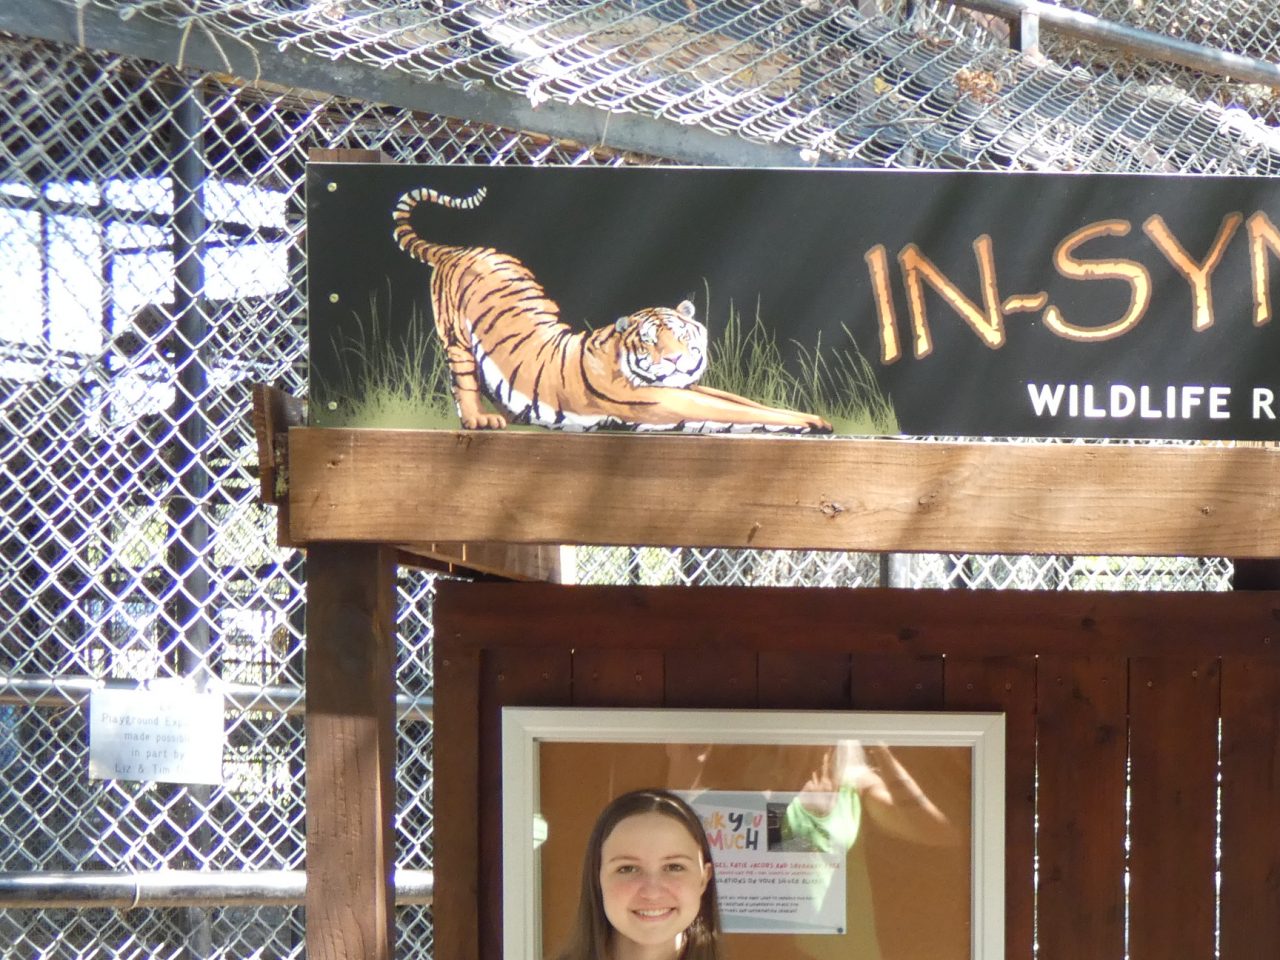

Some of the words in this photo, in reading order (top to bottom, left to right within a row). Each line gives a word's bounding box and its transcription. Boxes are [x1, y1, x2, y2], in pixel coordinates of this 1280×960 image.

[1027, 383, 1232, 420] WILDLIFE
[124, 732, 151, 742] made
[131, 747, 141, 758] in
[146, 749, 168, 760] part
[173, 749, 185, 761] by
[114, 762, 132, 774] Liz
[152, 763, 171, 774] Tim
[706, 827, 759, 850] MUCH
